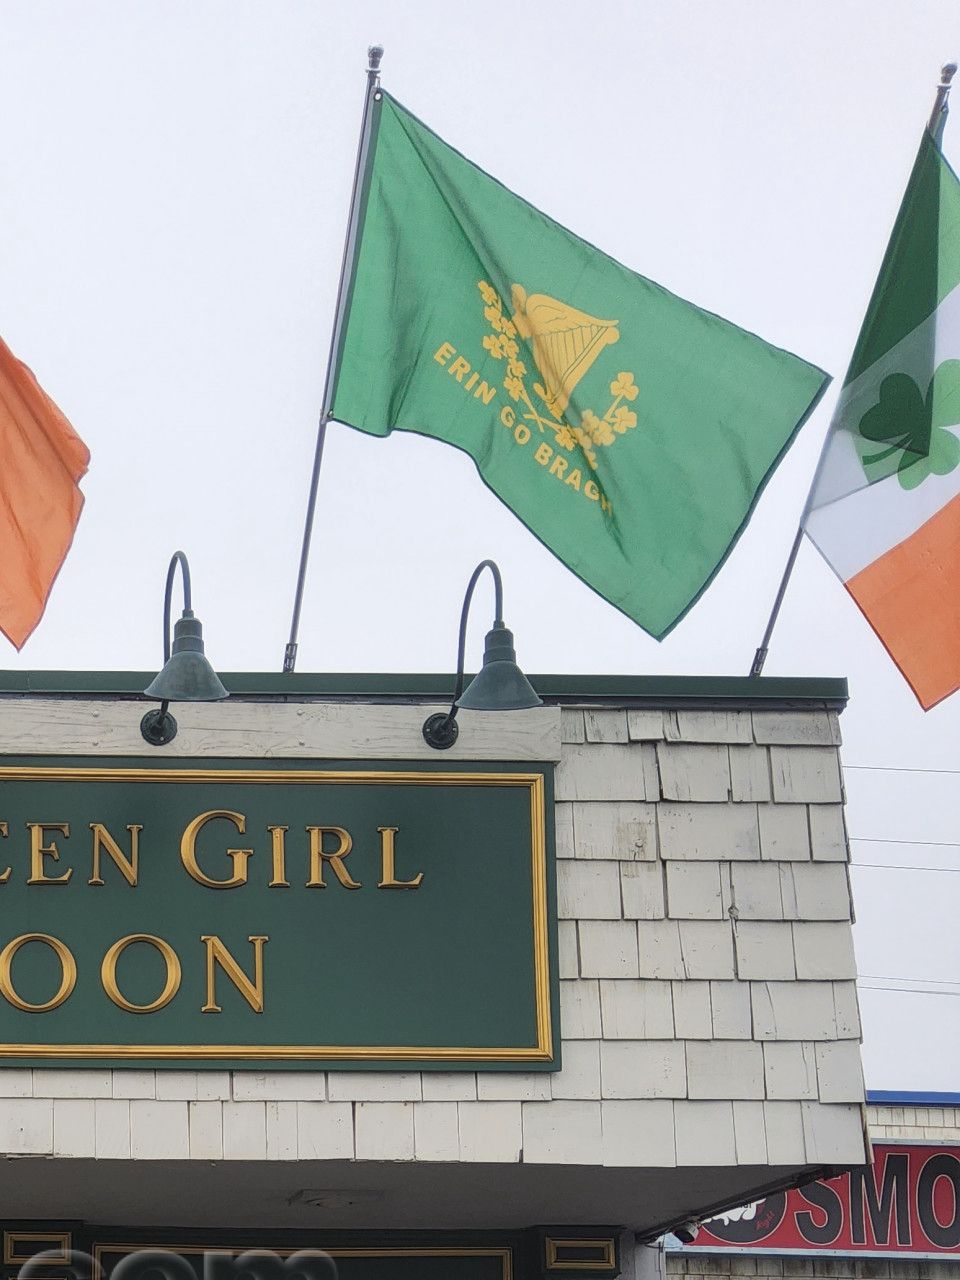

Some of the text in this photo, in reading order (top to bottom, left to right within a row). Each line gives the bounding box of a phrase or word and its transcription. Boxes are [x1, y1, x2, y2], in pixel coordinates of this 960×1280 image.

[433, 341, 497, 406] ERIN
[500, 406, 532, 445] GO
[179, 809, 424, 891] GIRL
